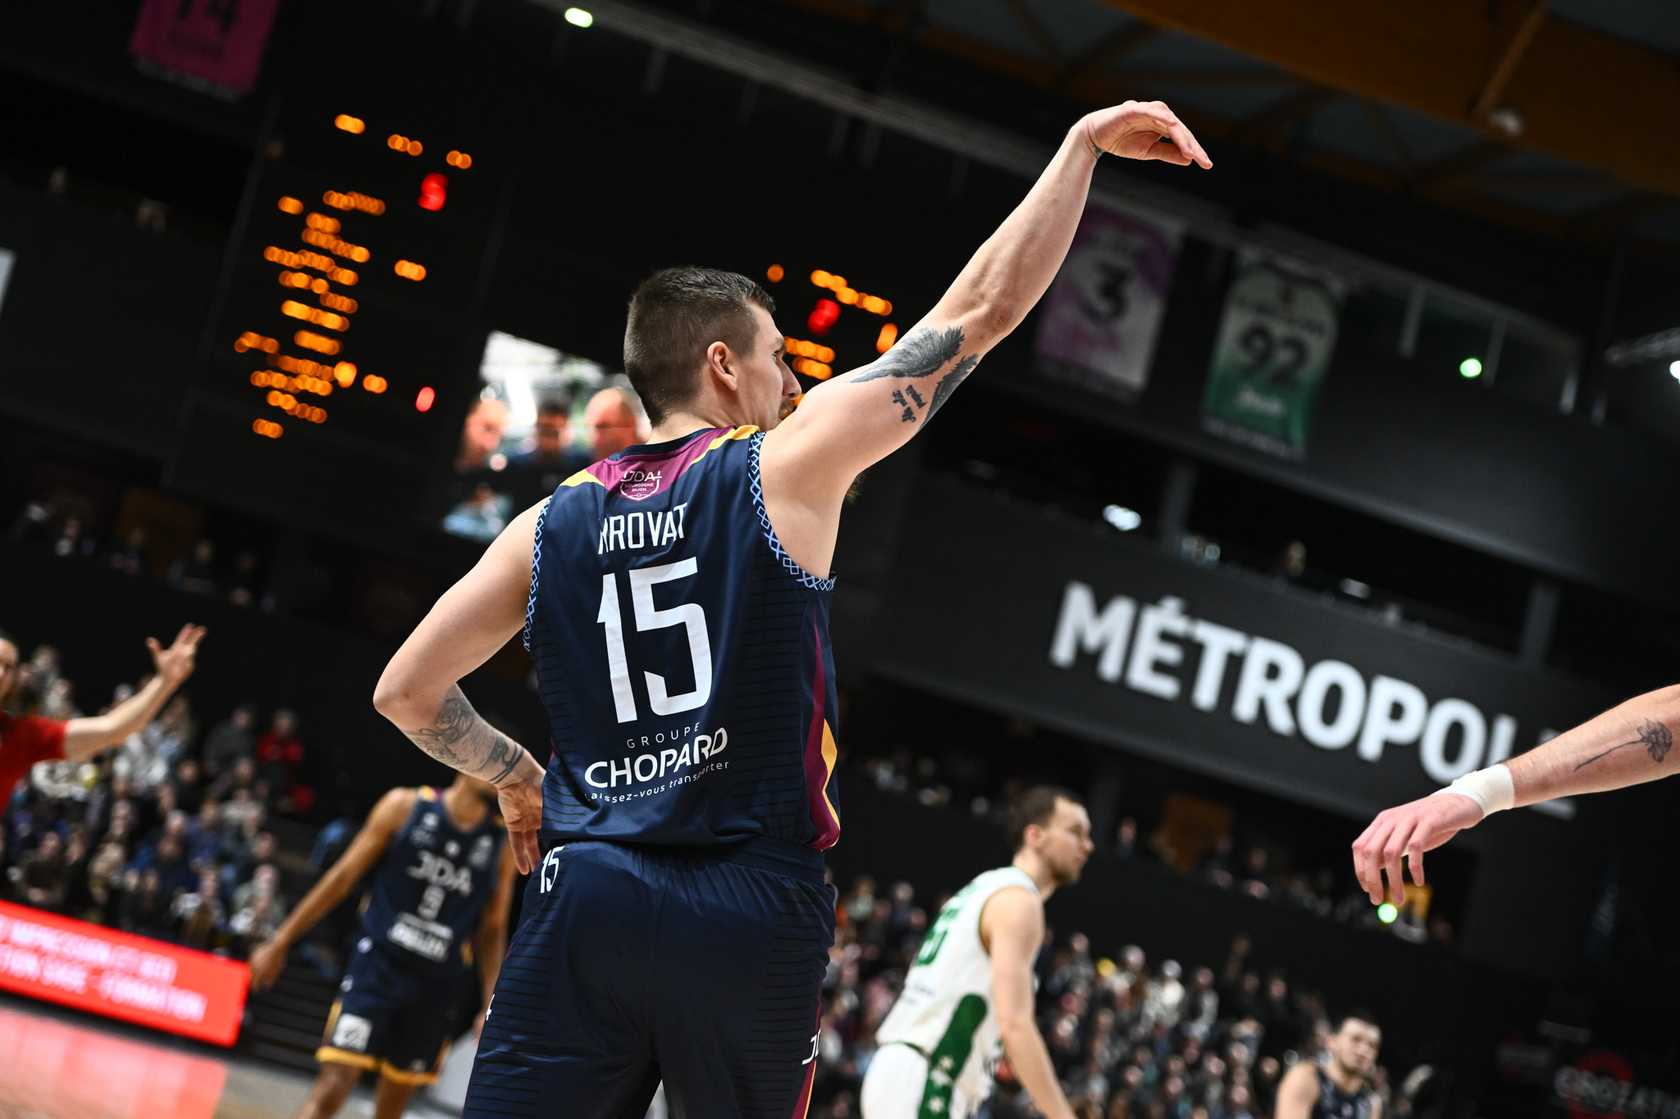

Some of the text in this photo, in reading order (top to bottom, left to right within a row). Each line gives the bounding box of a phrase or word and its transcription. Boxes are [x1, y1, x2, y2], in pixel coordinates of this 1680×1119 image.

[597, 557, 713, 724] 15
[1050, 580, 1577, 821] MÉTROPO
[584, 727, 729, 789] CHOPARD
[626, 721, 701, 749] GROUPE
[585, 785, 666, 804] aissez-vous
[405, 849, 472, 898] JDA
[540, 845, 566, 894] 15
